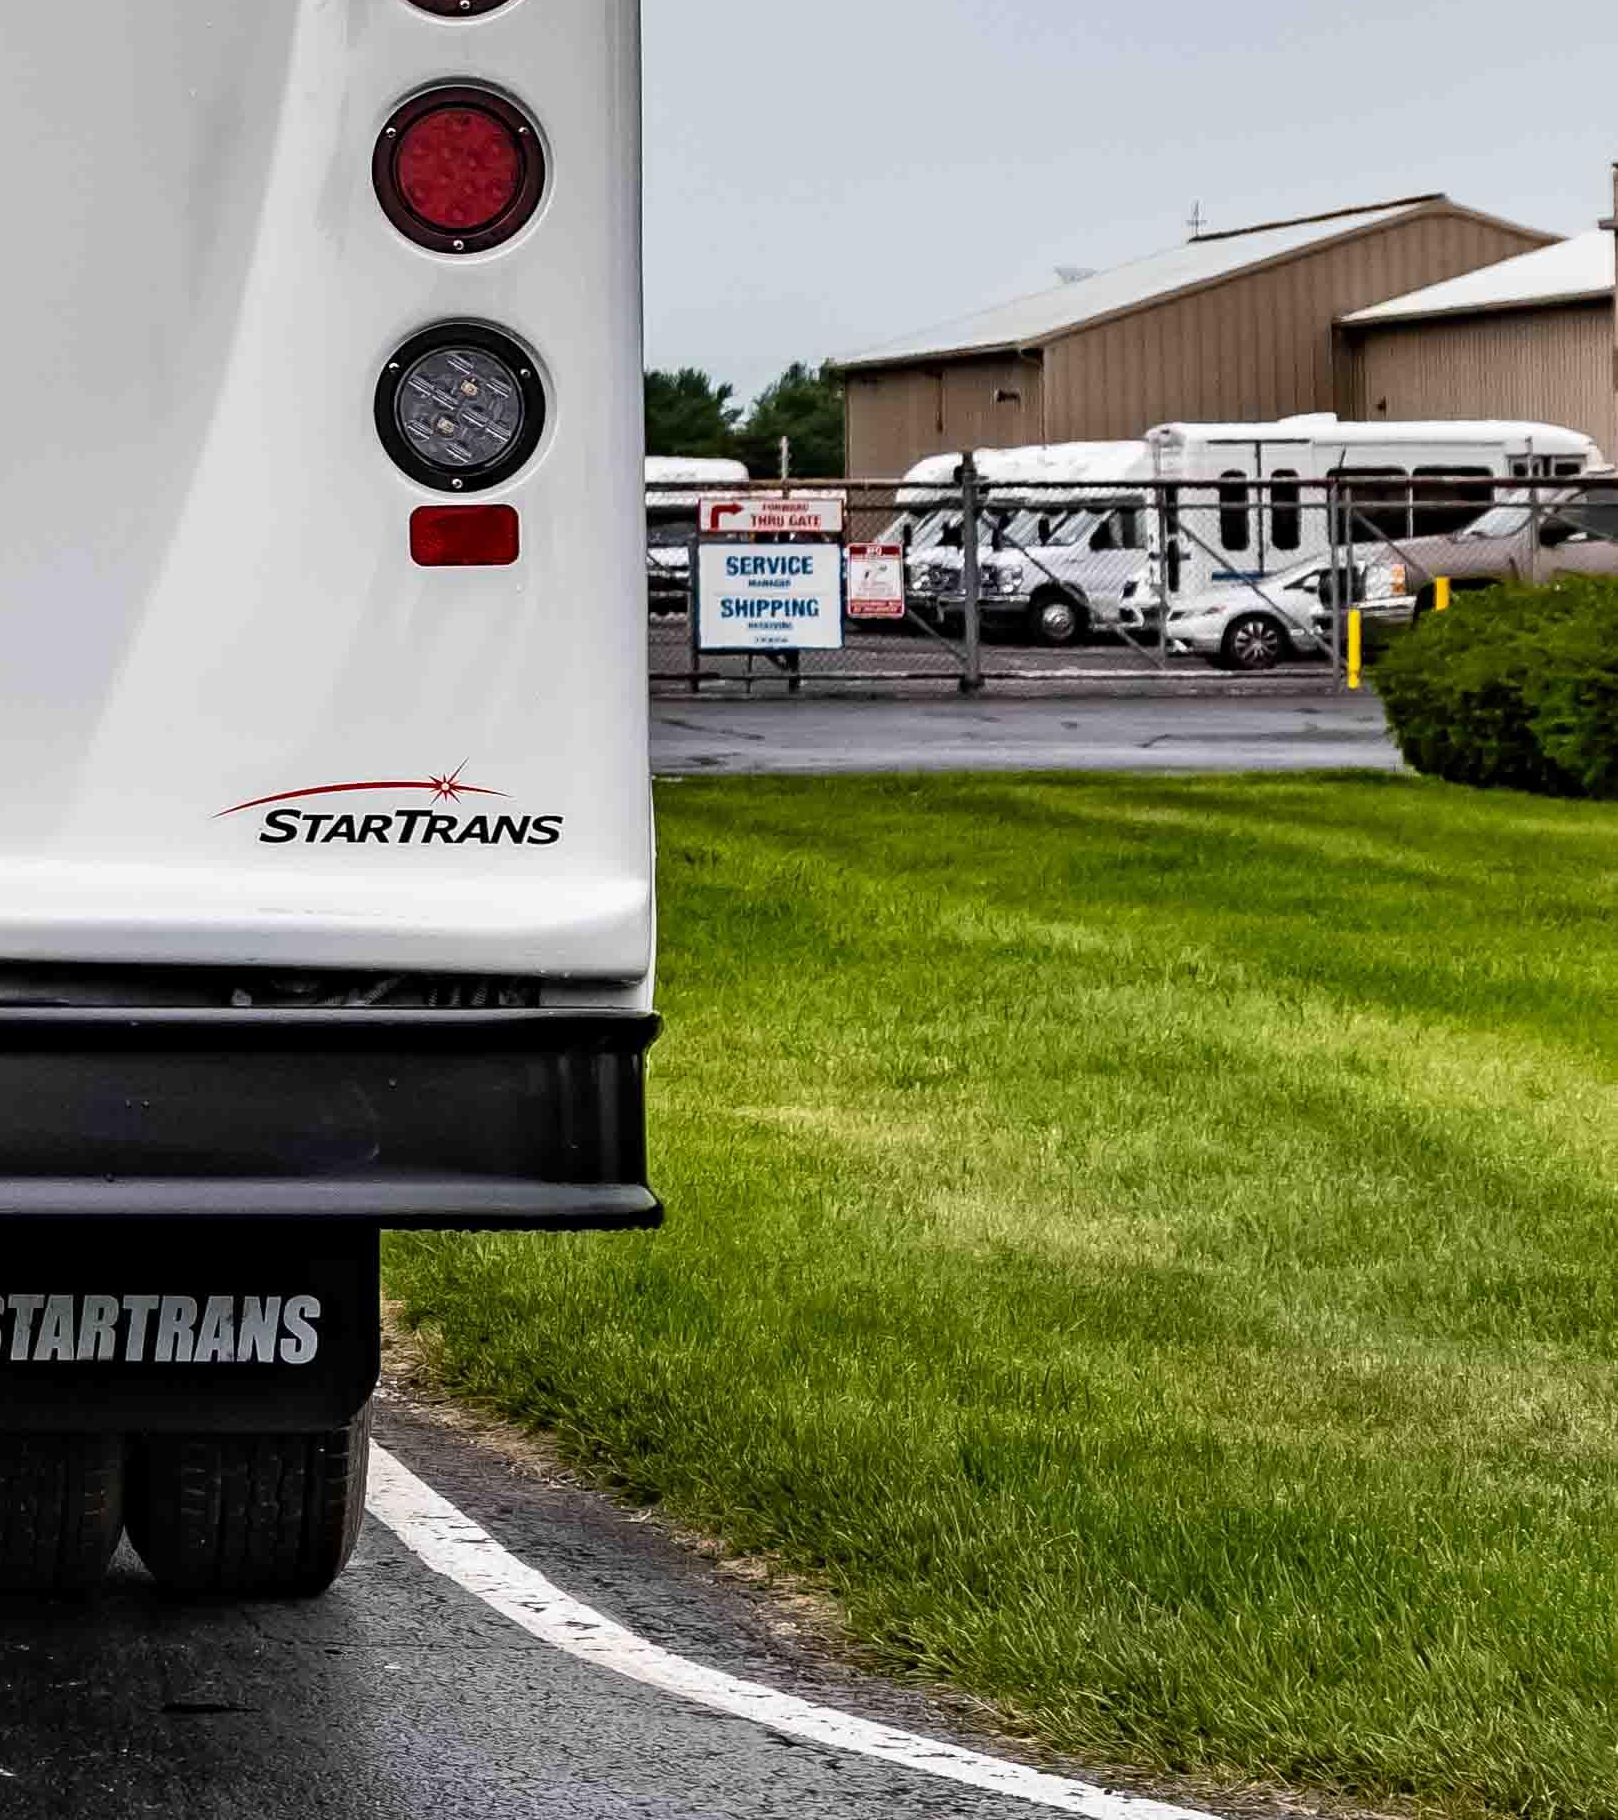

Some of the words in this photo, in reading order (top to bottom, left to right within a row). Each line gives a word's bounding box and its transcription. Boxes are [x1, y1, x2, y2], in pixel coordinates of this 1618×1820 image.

[751, 515, 784, 527] THRU
[789, 515, 821, 527] GATE
[726, 555, 814, 575] SERVICE
[720, 598, 820, 618] SHIPPING
